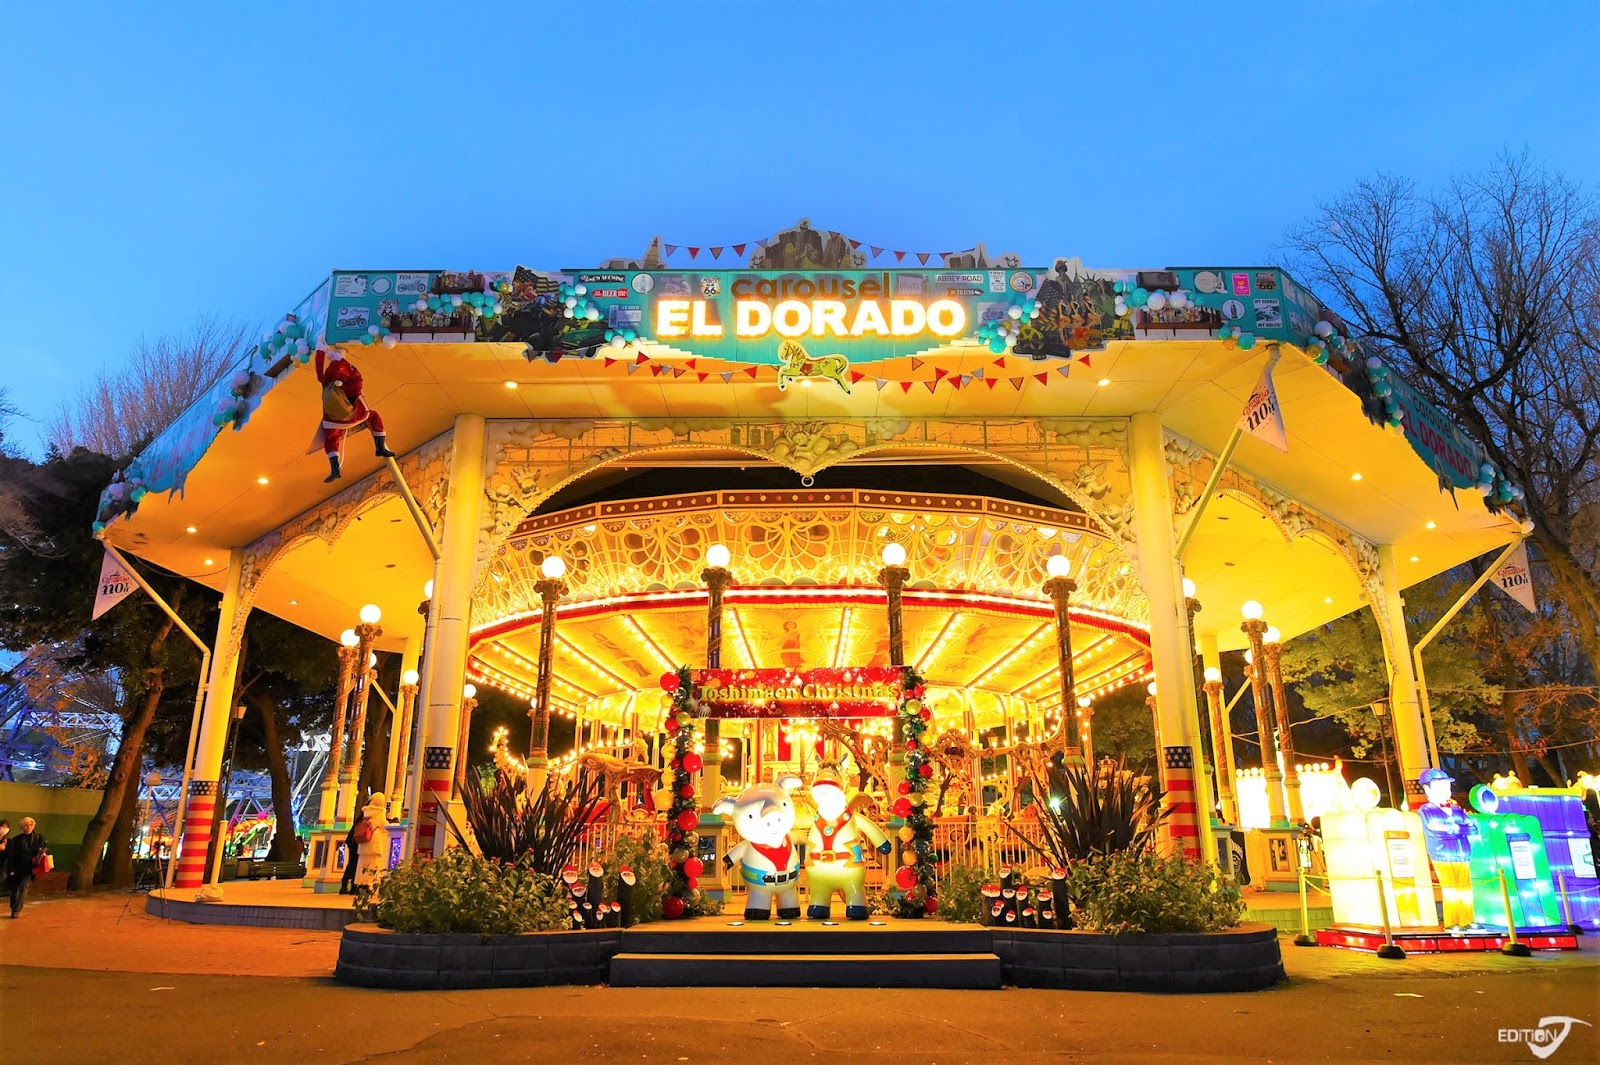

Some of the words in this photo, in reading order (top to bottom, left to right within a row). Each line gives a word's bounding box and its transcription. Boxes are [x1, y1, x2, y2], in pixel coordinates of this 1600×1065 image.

[602, 289, 617, 297] BEER
[704, 286, 717, 295] 66
[731, 272, 891, 299] carousel
[381, 309, 394, 317] 66
[656, 299, 723, 337] EL
[736, 298, 967, 337] DORADO
[1418, 419, 1473, 481] DORADO
[699, 684, 797, 701] Toshimaen
[801, 683, 898, 699] Christmas
